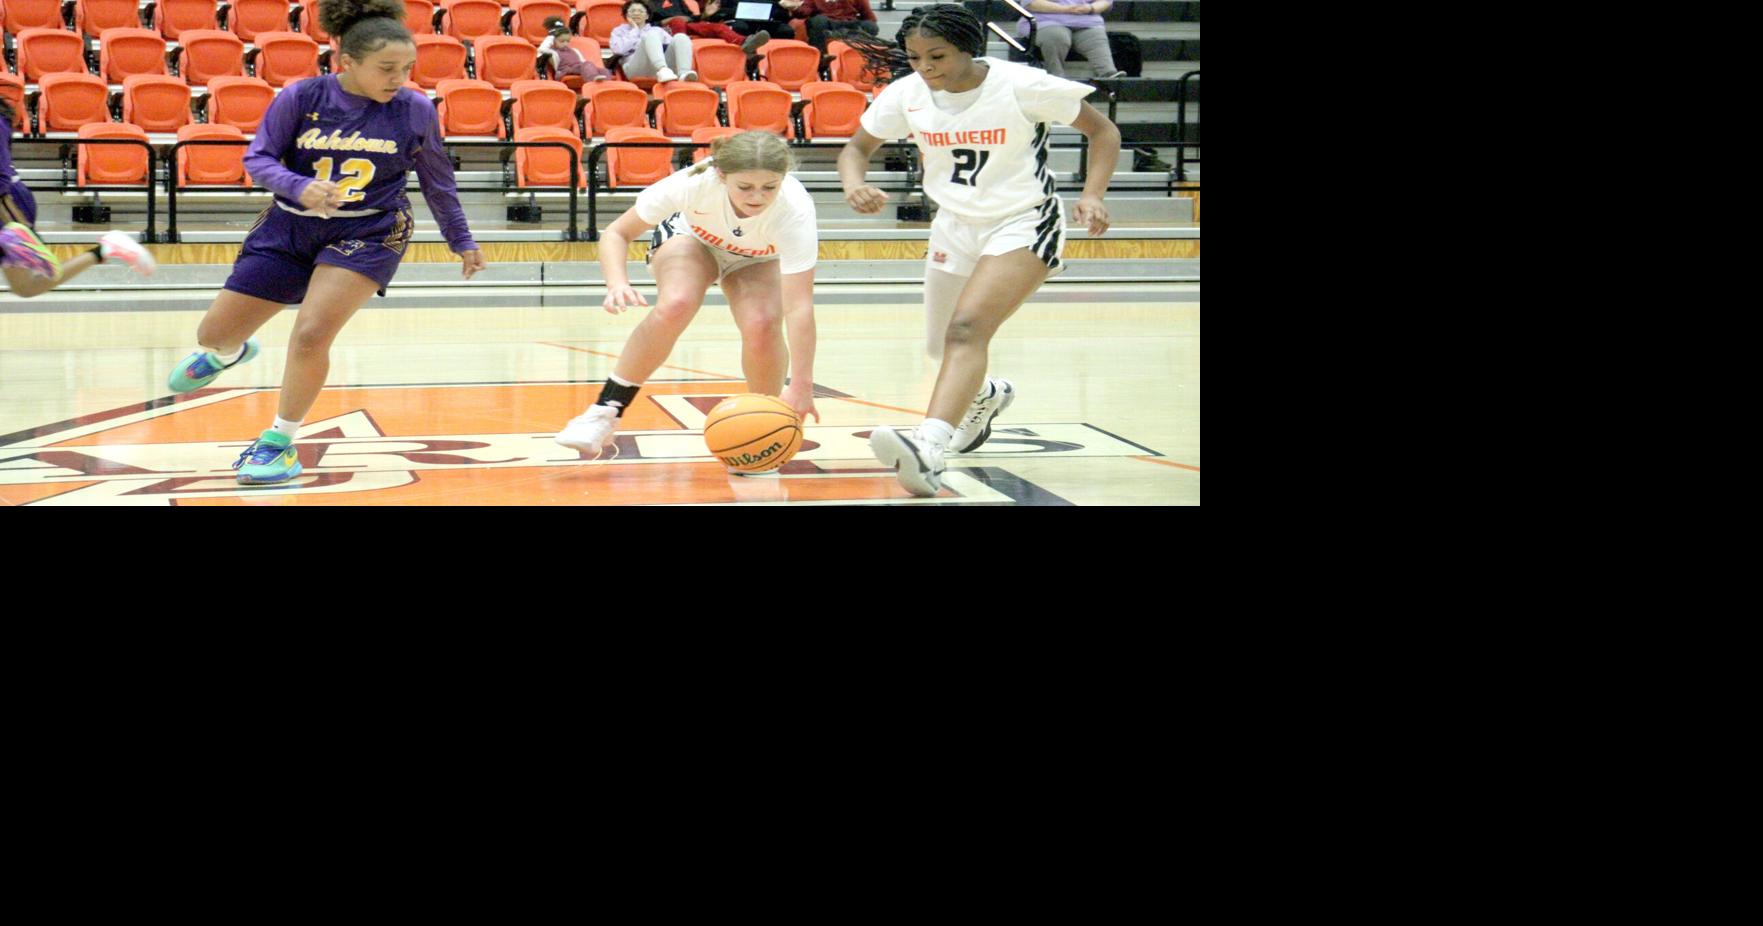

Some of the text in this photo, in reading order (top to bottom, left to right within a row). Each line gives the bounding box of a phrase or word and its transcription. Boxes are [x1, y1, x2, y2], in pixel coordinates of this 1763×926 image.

[297, 127, 398, 154] Ashdown
[920, 128, 1006, 147] MALVERN
[312, 156, 376, 202] 12
[950, 148, 990, 187] 21
[722, 441, 783, 467] Wilson
